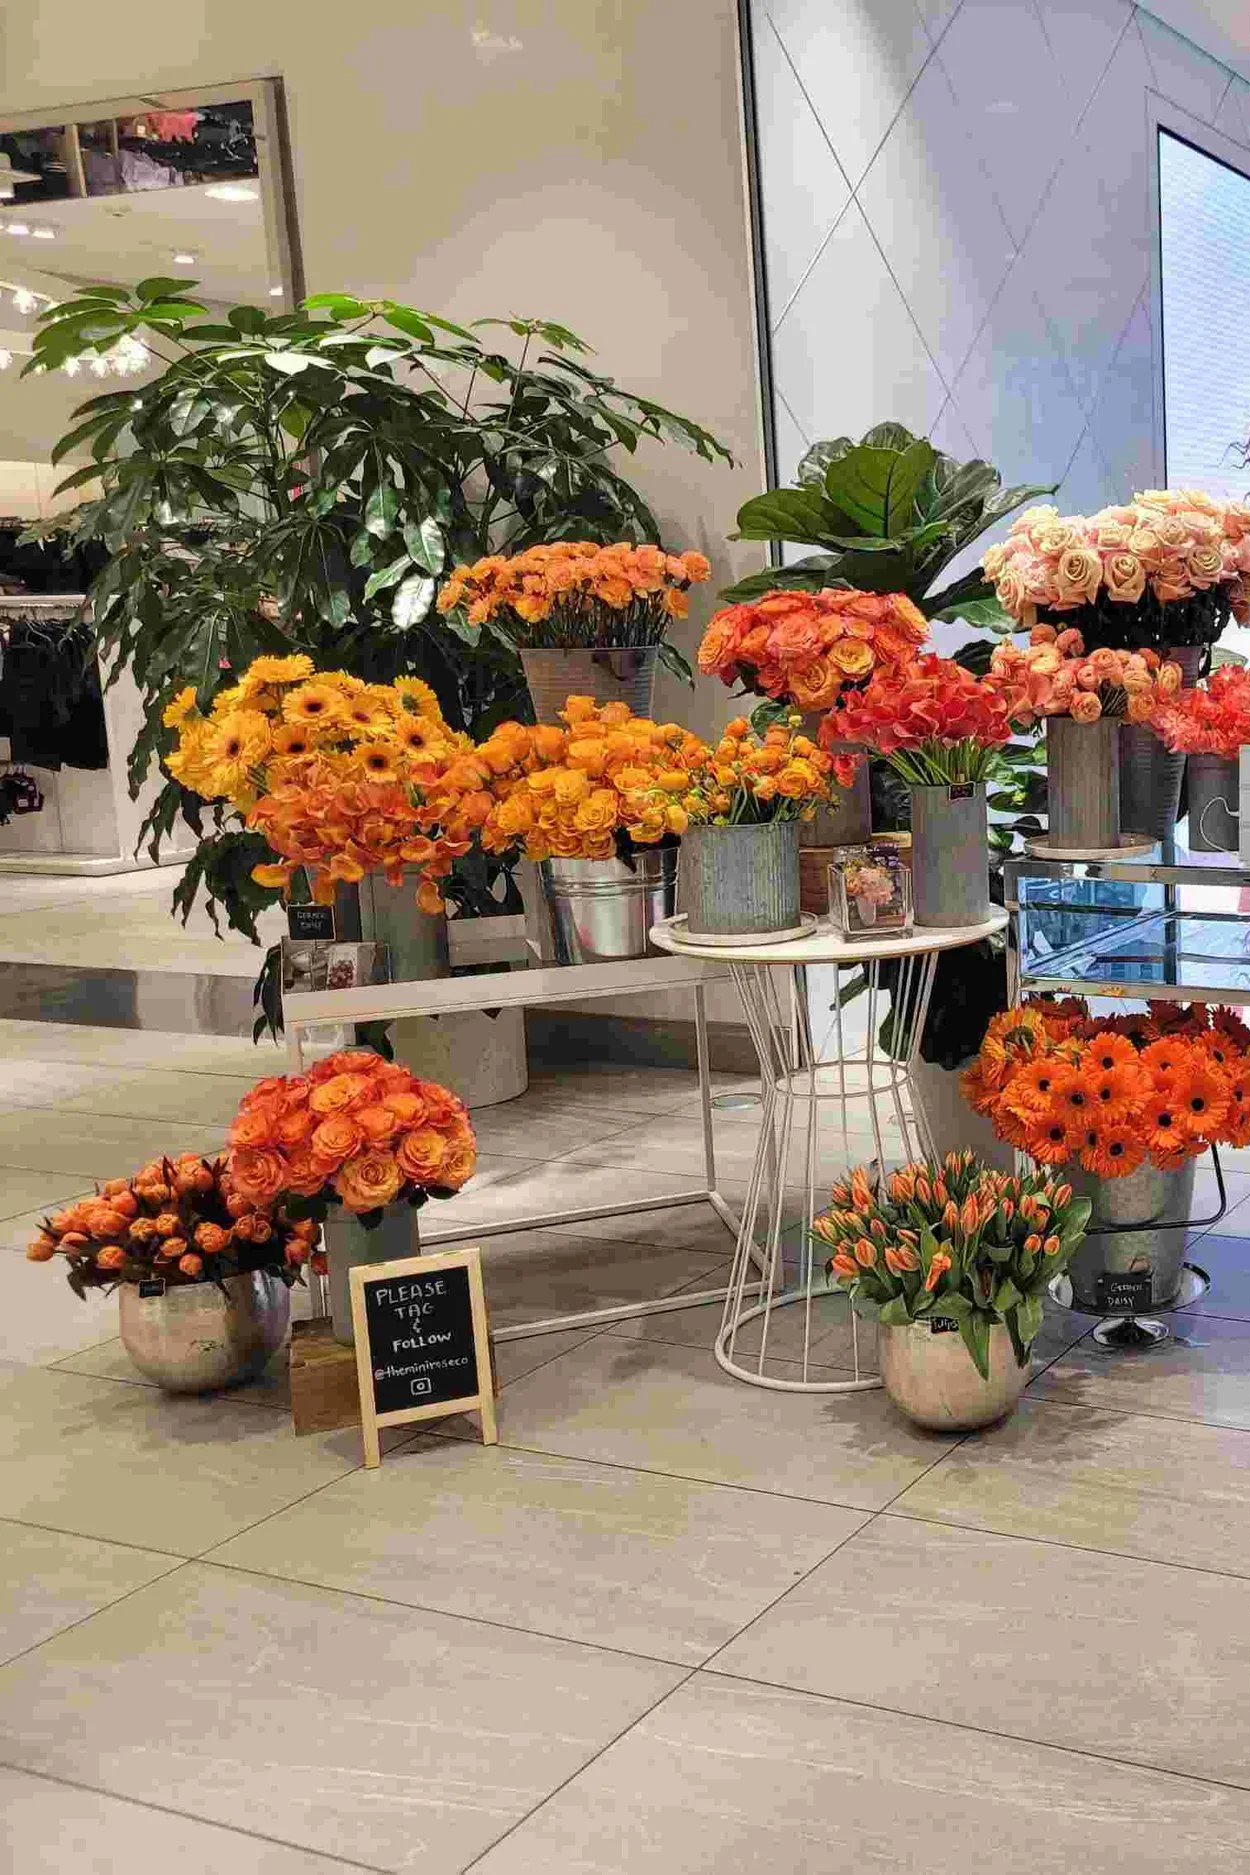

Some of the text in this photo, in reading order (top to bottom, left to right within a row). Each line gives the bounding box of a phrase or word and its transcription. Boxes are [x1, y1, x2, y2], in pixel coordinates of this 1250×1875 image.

[376, 1280, 447, 1306] PLEASE
[1107, 1296, 1135, 1307] DAISY
[393, 1303, 435, 1320] TAG
[392, 1332, 452, 1353] FOLLOW
